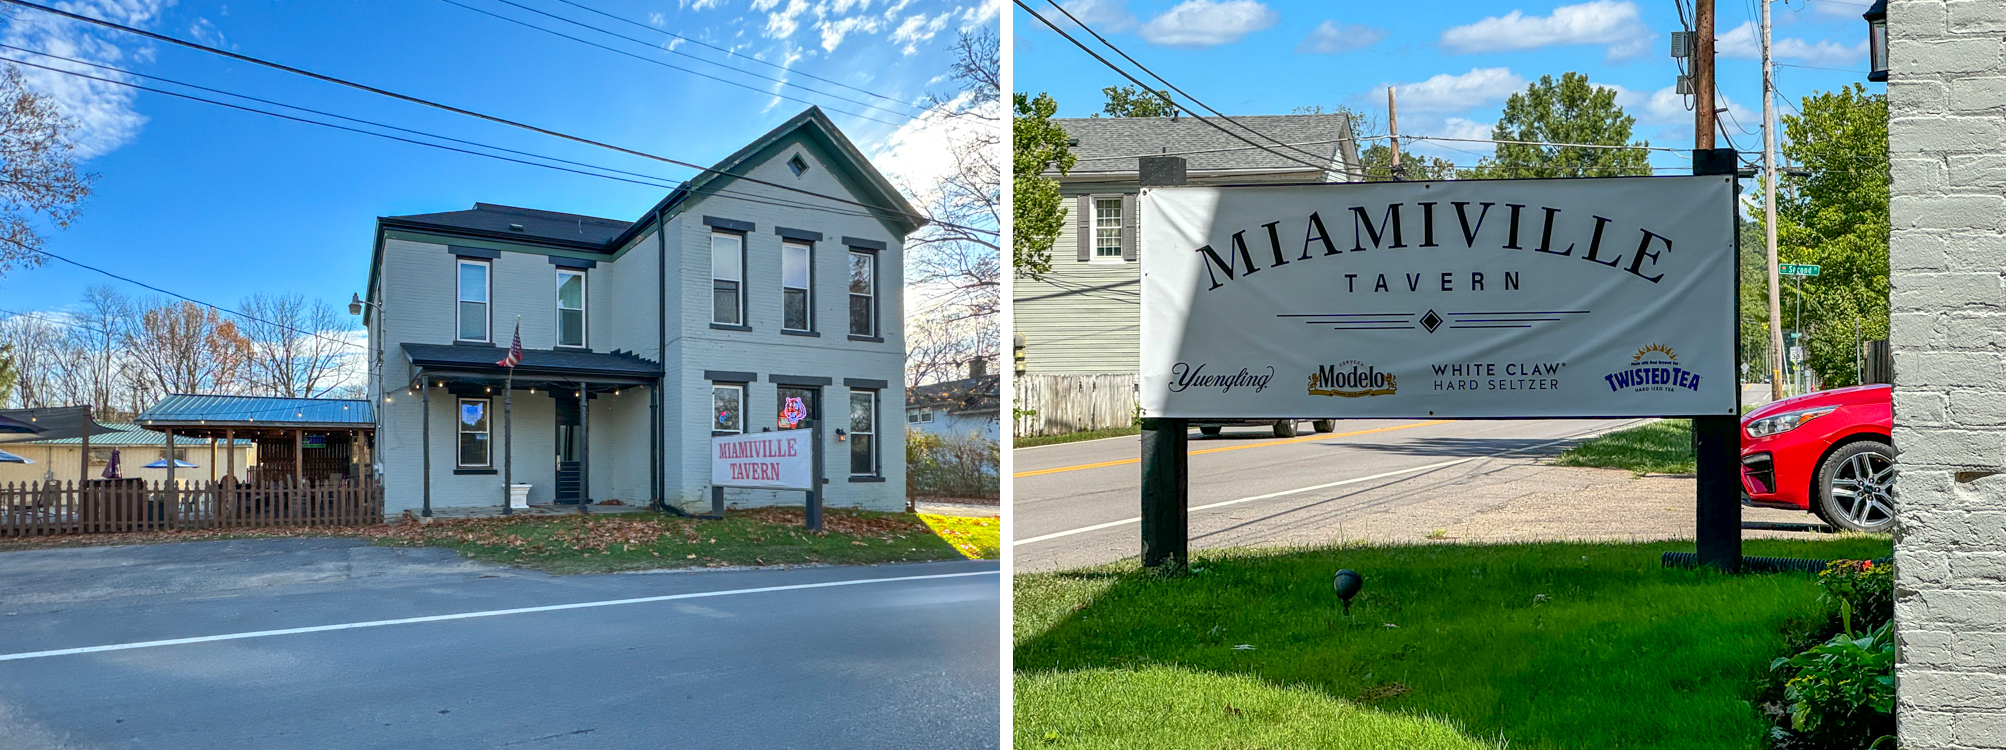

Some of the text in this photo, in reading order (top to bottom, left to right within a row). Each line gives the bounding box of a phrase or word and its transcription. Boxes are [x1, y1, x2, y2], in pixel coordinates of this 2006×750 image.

[1195, 201, 1673, 291] MIAMIVILLE
[1788, 265, 1812, 274] Second
[1344, 271, 1520, 293] TAVERN
[1168, 362, 1275, 393] Yuengling
[1318, 364, 1385, 388] Modelo
[1431, 363, 1496, 376] WHITE
[1604, 367, 1701, 392] TWISTED TEA
[1434, 379, 1559, 391] HARD SELTZER
[718, 437, 798, 459] MIAMIVILLE
[729, 462, 781, 481] TAVERN
